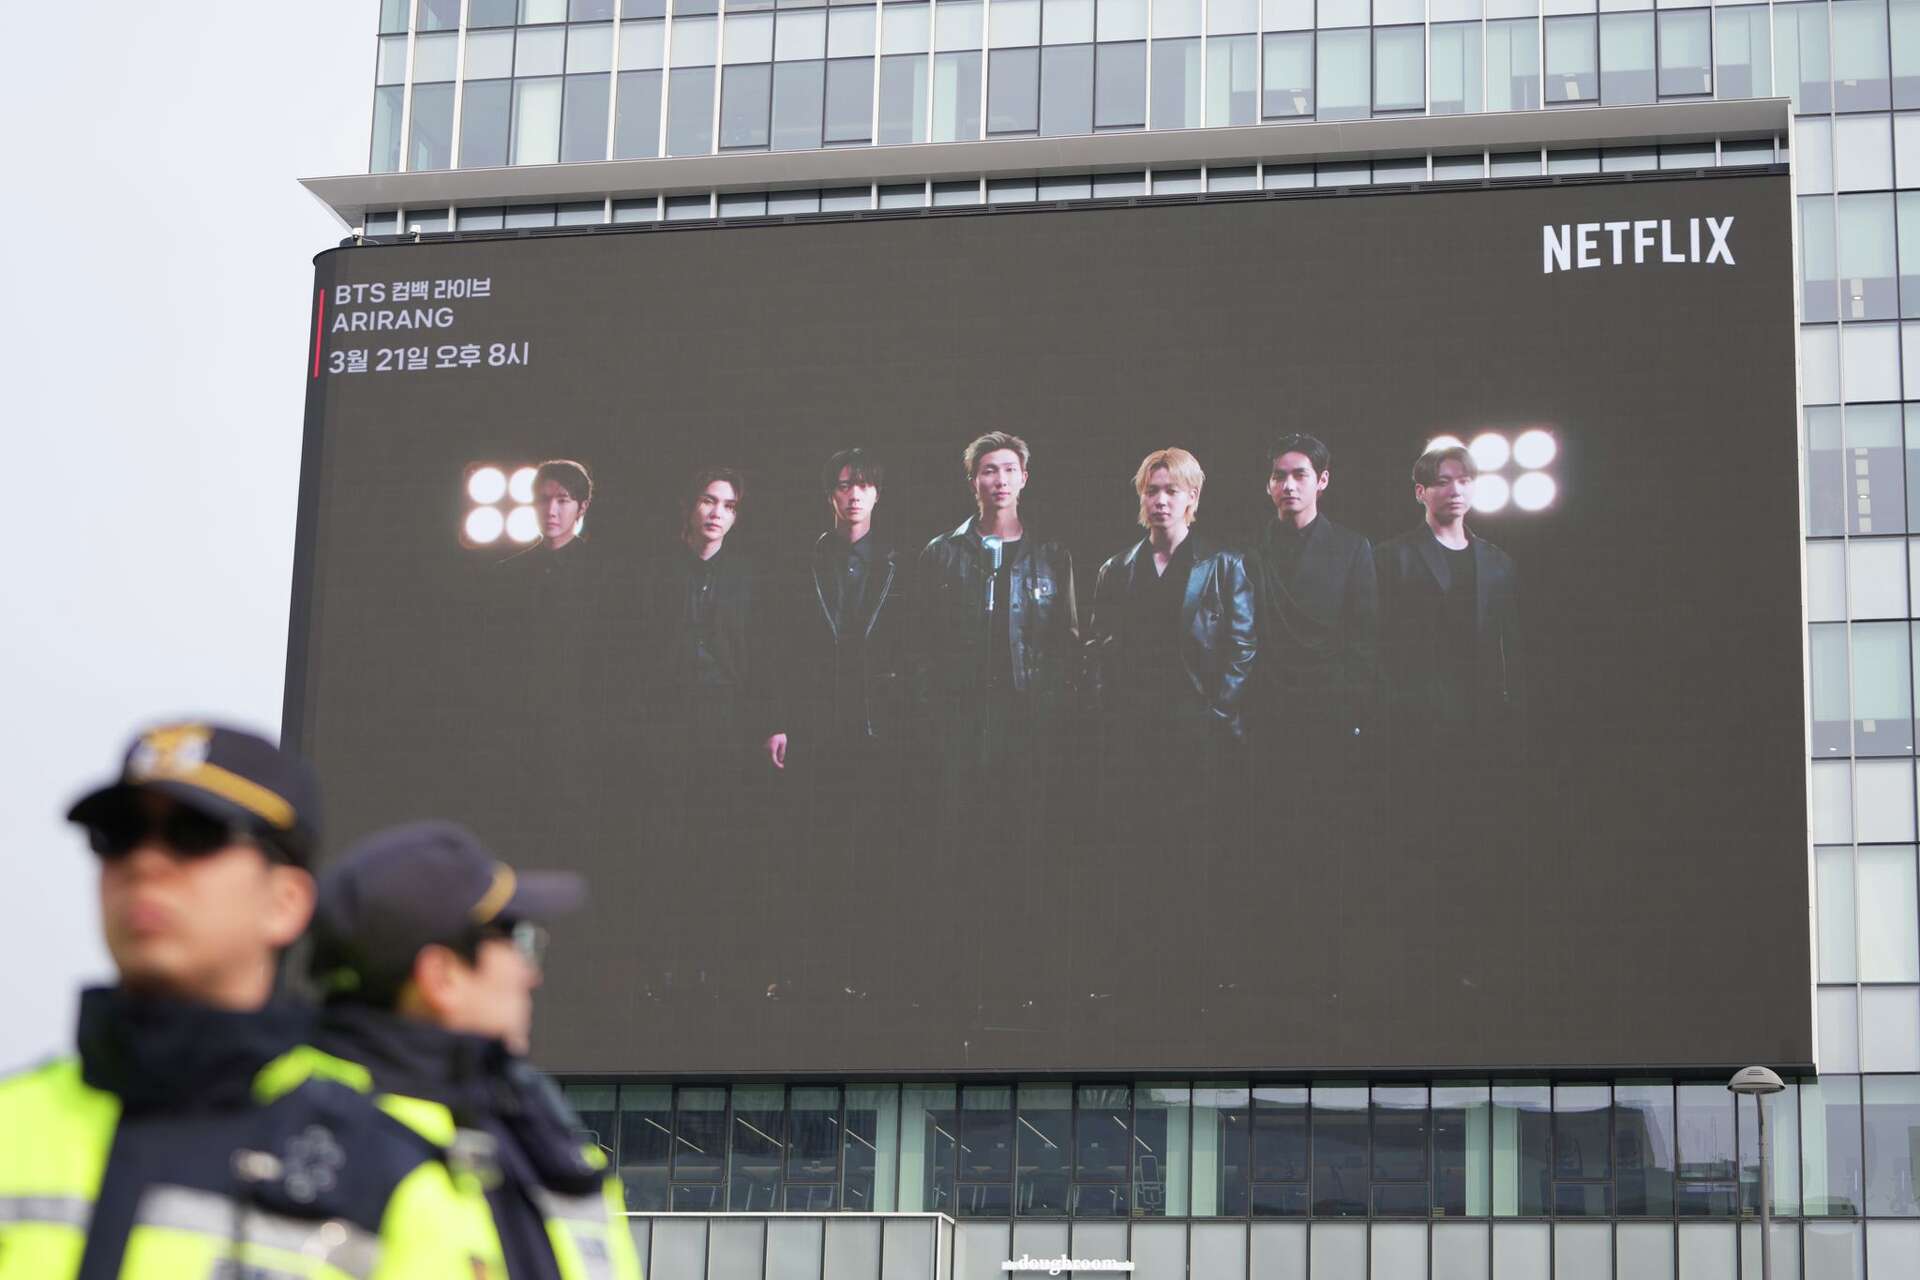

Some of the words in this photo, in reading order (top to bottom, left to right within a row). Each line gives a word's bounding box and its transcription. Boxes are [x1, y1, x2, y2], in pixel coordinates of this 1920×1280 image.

[1543, 216, 1736, 274] NETFLIX
[335, 283, 386, 305] BTS
[392, 280, 430, 302] 컴백
[434, 277, 492, 300] 라이브
[331, 307, 454, 333] ARIRANG
[329, 349, 368, 374] 3월
[375, 346, 429, 371] 21일
[435, 343, 481, 368] 오후
[487, 341, 530, 367] 8시
